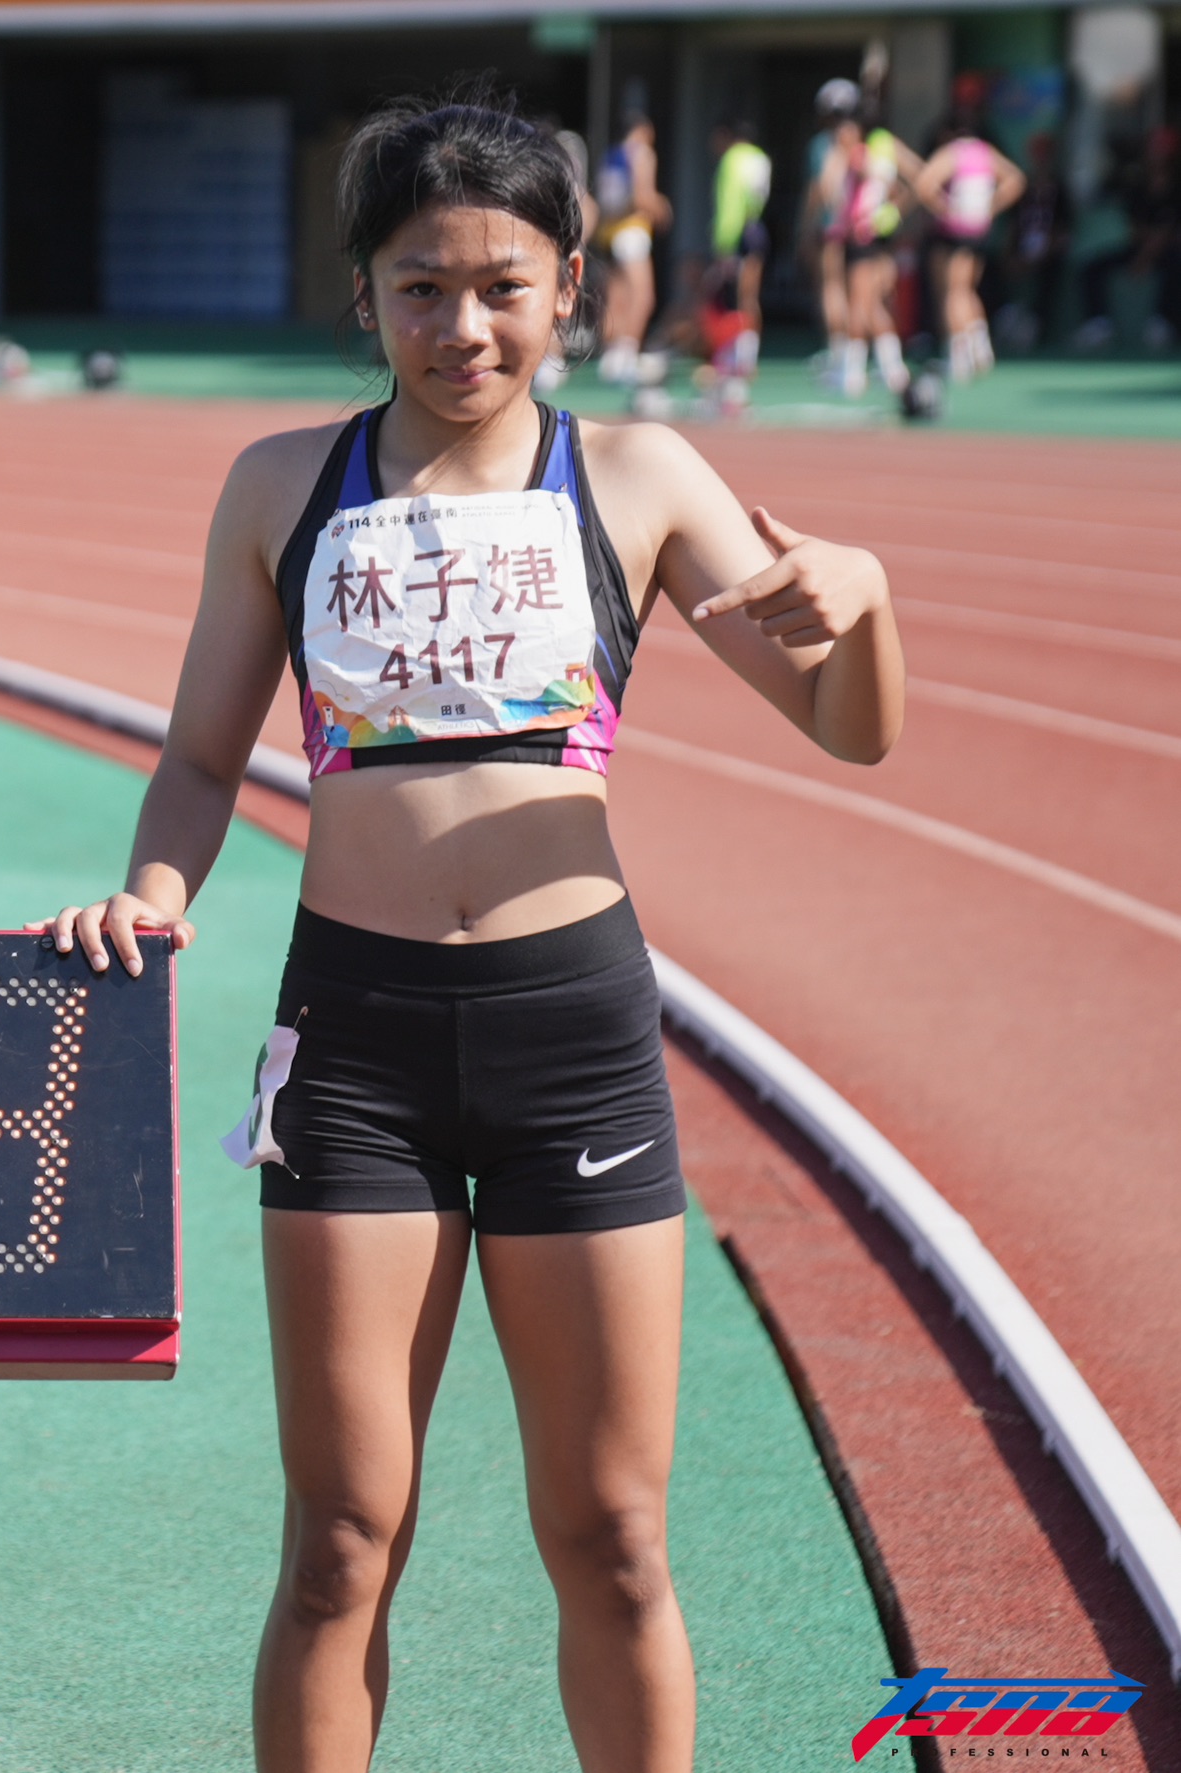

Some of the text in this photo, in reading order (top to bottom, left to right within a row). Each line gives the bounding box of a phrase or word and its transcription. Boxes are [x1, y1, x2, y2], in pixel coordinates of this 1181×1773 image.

[348, 516, 371, 530] 114
[326, 544, 564, 632] 林子婕
[379, 632, 516, 690] 4117
[440, 703, 467, 717] 田徑
